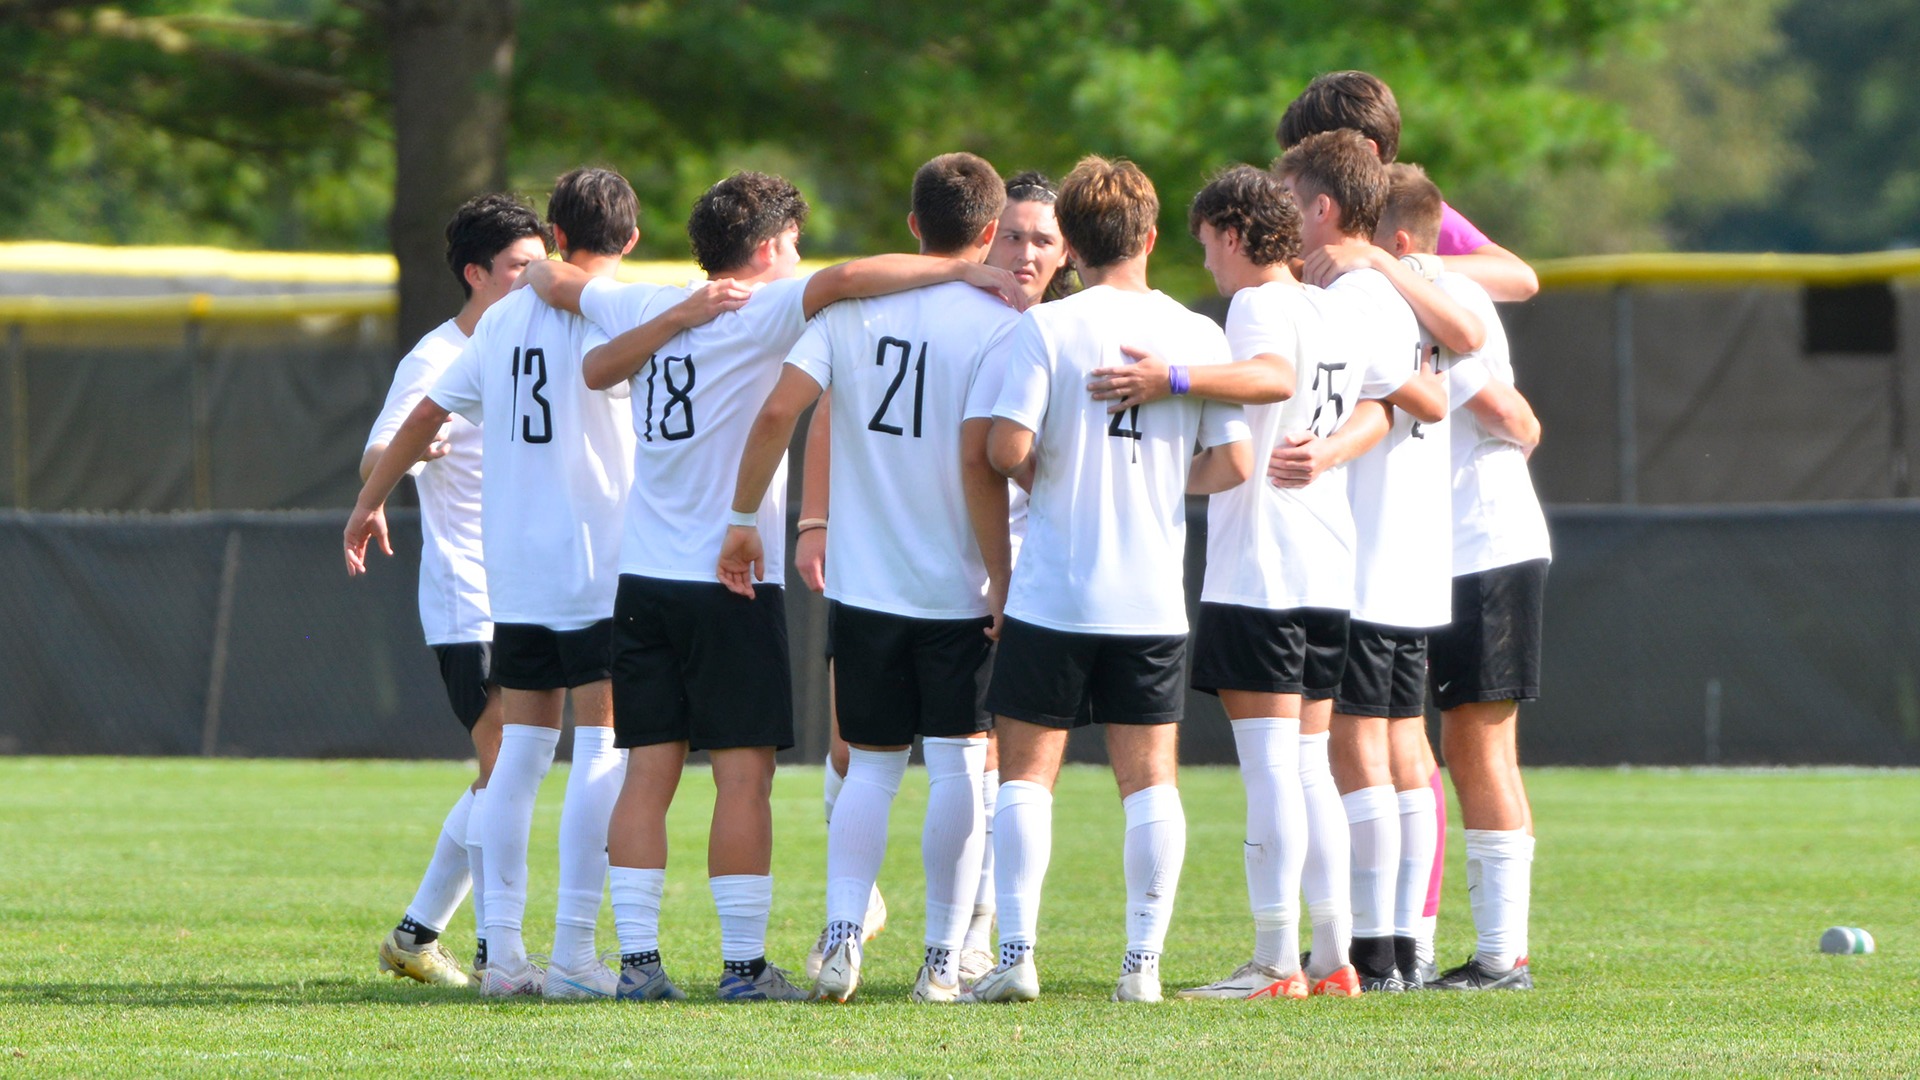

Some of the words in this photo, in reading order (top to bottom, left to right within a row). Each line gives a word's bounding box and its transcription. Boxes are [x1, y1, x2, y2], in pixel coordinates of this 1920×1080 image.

[510, 346, 552, 444] 13
[645, 353, 696, 442] 18
[868, 336, 926, 438] 21
